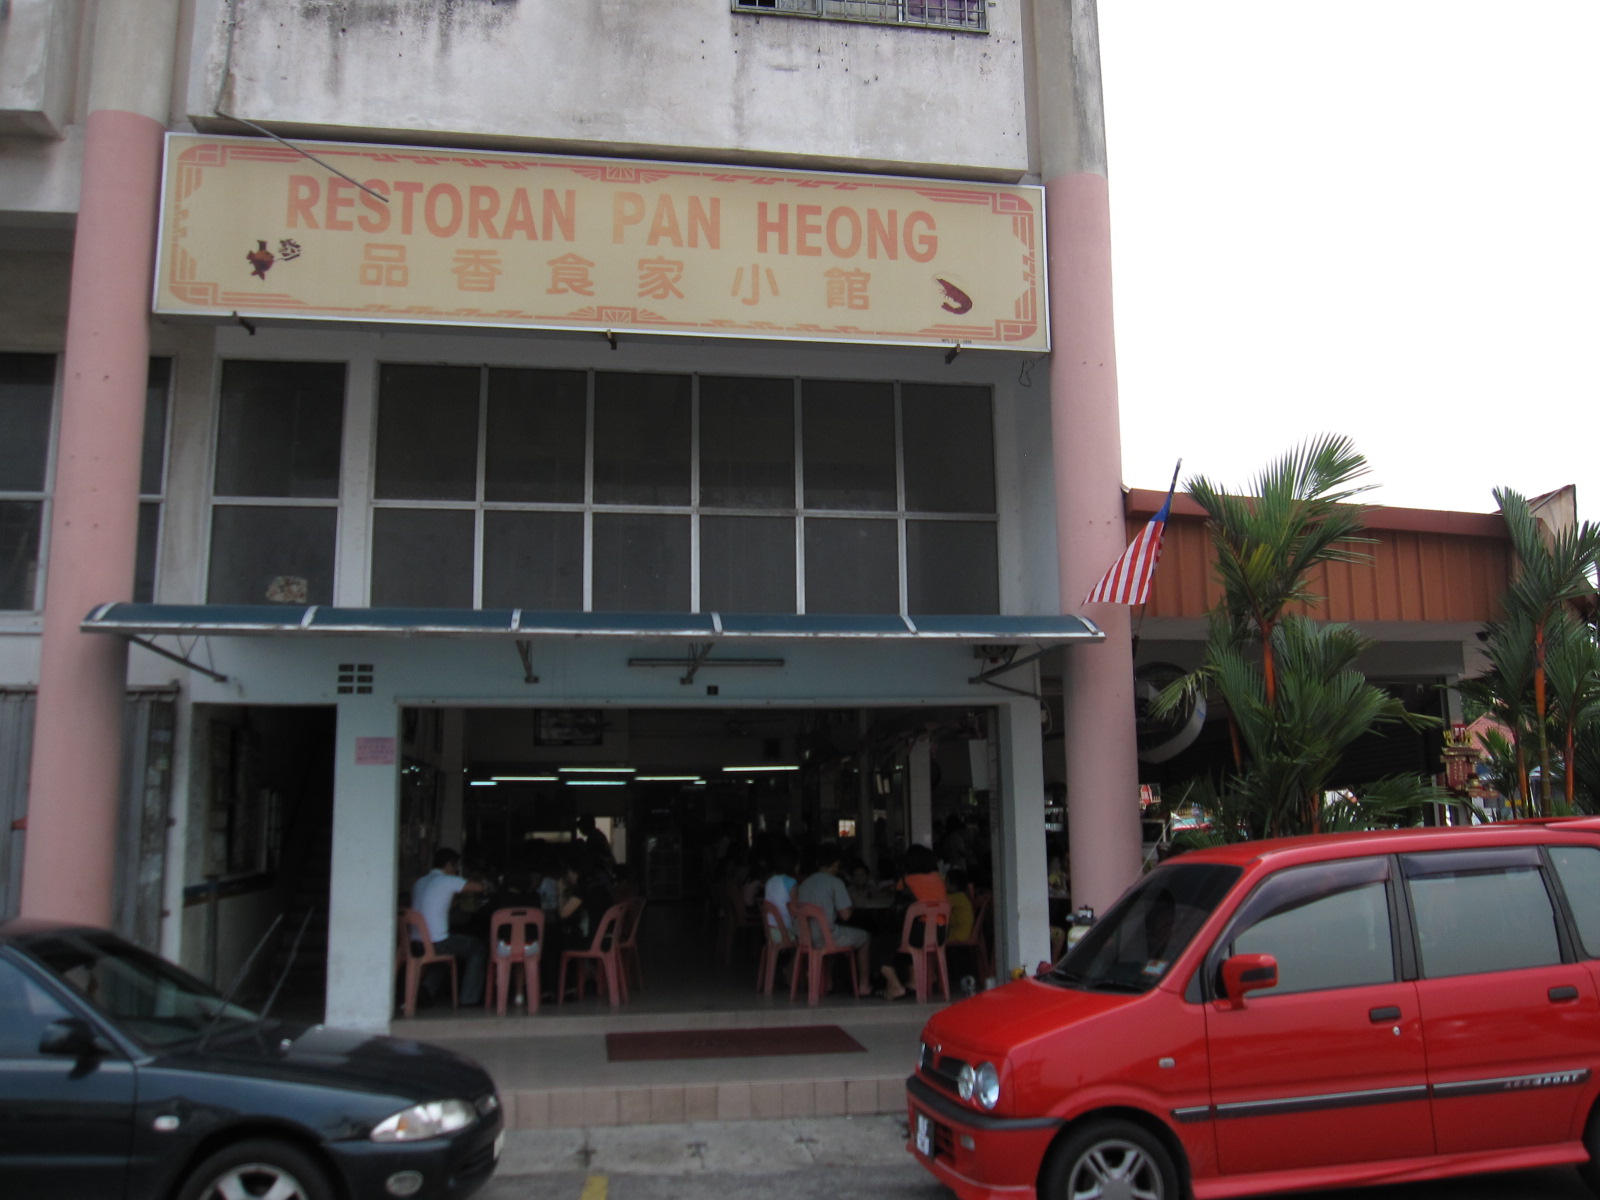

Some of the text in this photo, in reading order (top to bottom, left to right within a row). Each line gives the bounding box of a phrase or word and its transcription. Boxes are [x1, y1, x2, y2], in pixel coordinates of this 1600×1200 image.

[286, 174, 938, 263] RESTORAN PAN HEONG
[359, 242, 871, 310] 品香食家小館
